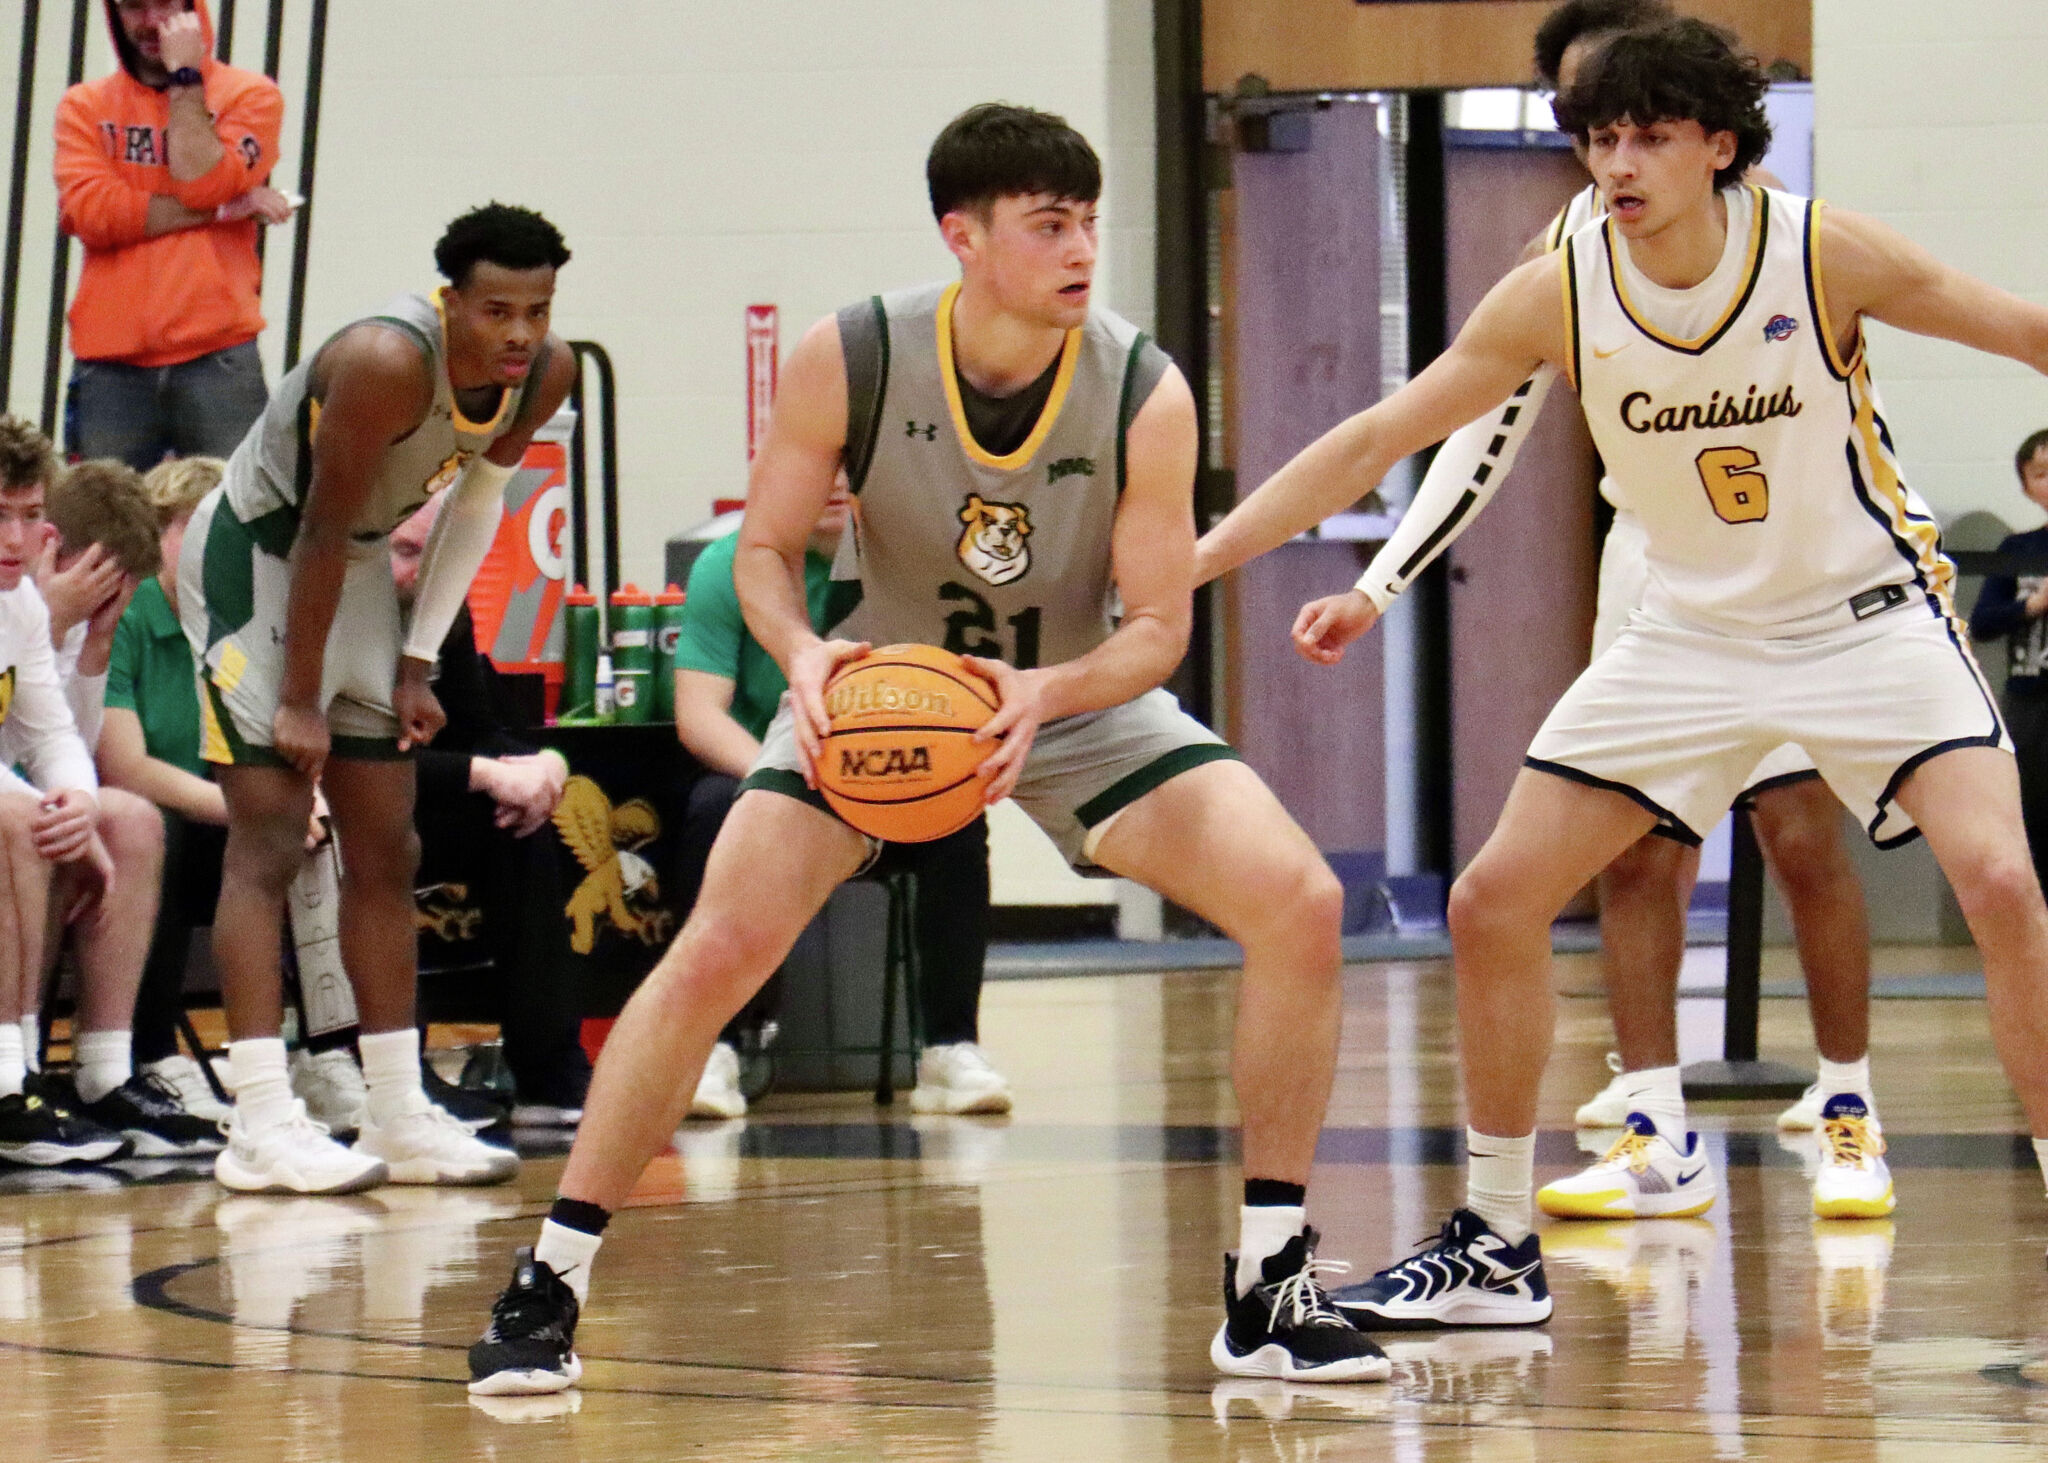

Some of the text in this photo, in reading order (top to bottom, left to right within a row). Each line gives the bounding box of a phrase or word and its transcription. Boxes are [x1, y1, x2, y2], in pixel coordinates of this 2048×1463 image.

[1620, 384, 1802, 434] Canisius
[1695, 446, 1769, 525] 6
[528, 484, 567, 581] G
[937, 580, 1042, 670] 21
[614, 679, 637, 708] G
[826, 679, 954, 720] Wilson
[840, 746, 933, 777] NCAA
